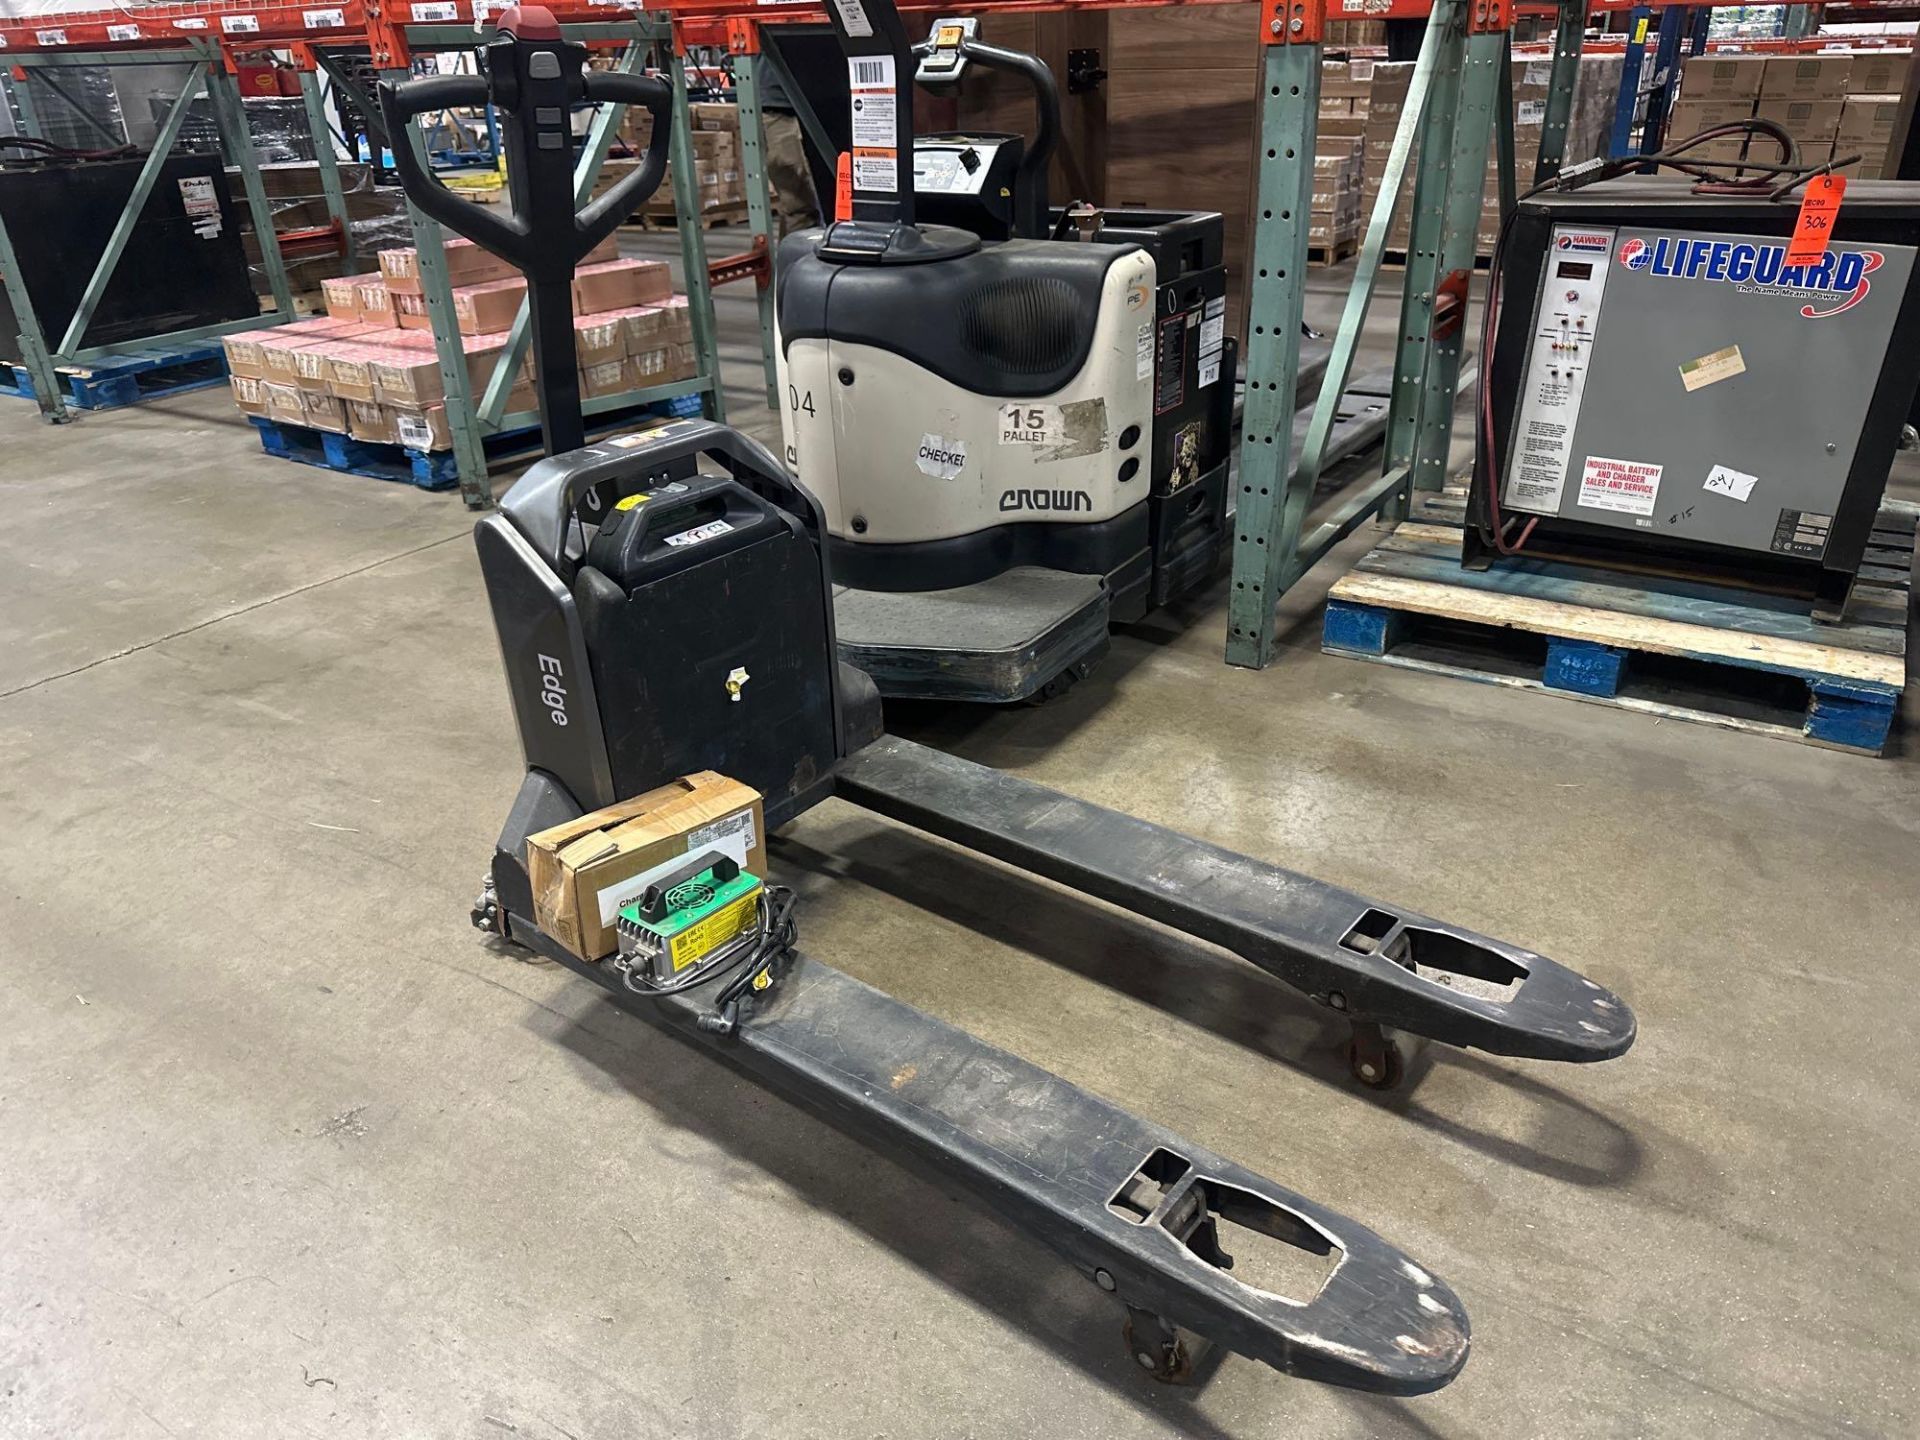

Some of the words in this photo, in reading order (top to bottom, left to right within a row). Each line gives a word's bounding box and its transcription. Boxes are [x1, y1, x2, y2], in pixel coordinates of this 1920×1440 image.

[1804, 214, 1827, 230] 306
[1572, 235, 1608, 245] HAWKER
[1736, 284, 1752, 292] The
[1754, 286, 1780, 295] Name
[1780, 289, 1810, 298] Means
[1811, 291, 1841, 301] Power
[1007, 408, 1045, 430] 15
[1003, 430, 1047, 443] PALLET
[1586, 460, 1626, 473] INDUSTRIAL
[1627, 465, 1661, 477] BATTERY
[1596, 470, 1611, 479] AND
[1612, 472, 1646, 484] CHARGER
[1584, 477, 1606, 488] SALES
[1607, 480, 1623, 490] AND
[1623, 482, 1654, 494] SERVICE
[1000, 489, 1092, 512] CROWN
[537, 653, 569, 726] Edge
